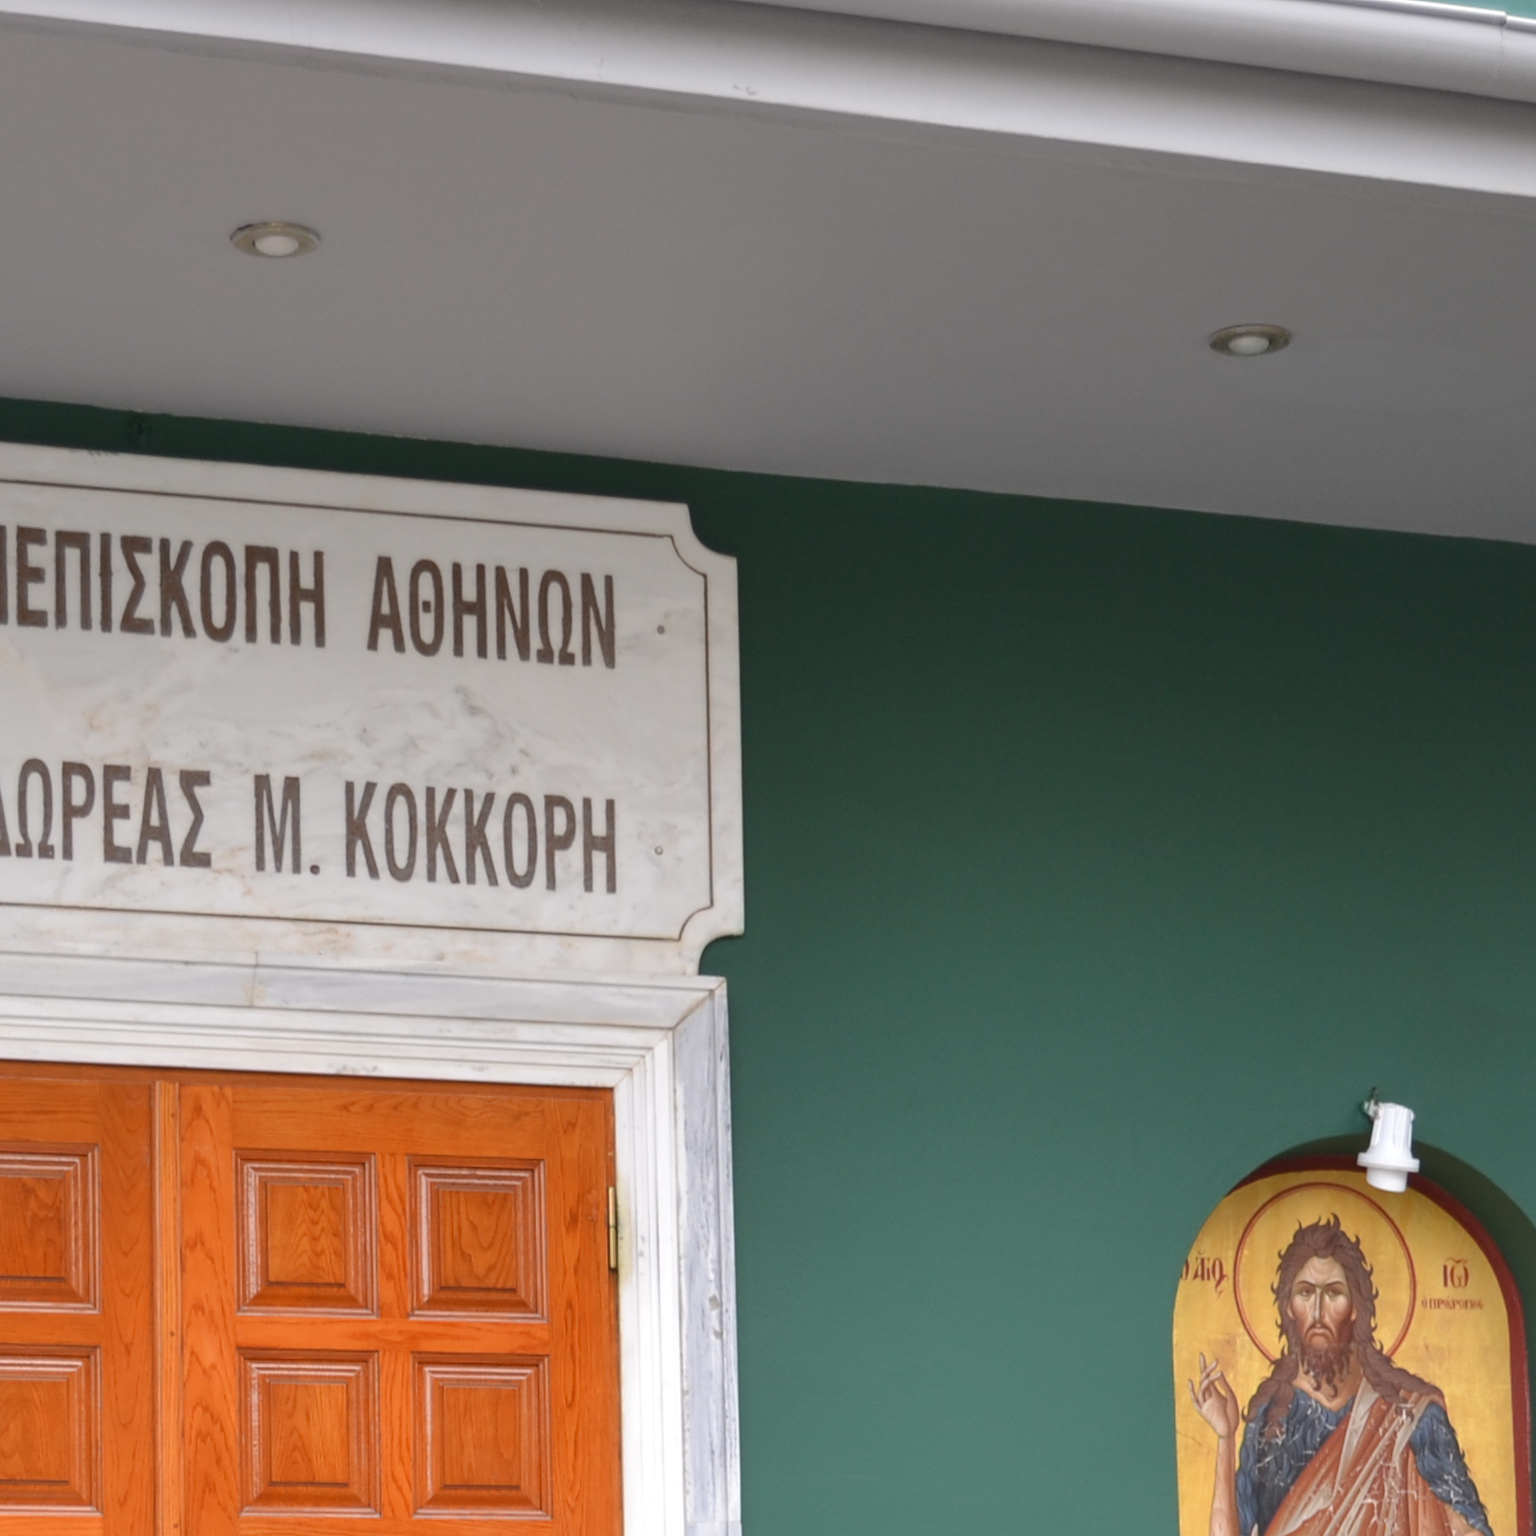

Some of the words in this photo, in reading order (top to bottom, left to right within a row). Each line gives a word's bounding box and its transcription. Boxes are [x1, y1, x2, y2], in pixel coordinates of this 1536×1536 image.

[366, 555, 616, 669] ΑΘΗΝΩΝ
[254, 772, 321, 876] Μ.
[344, 780, 617, 894] ΚΟΚΚΟΡΗ
